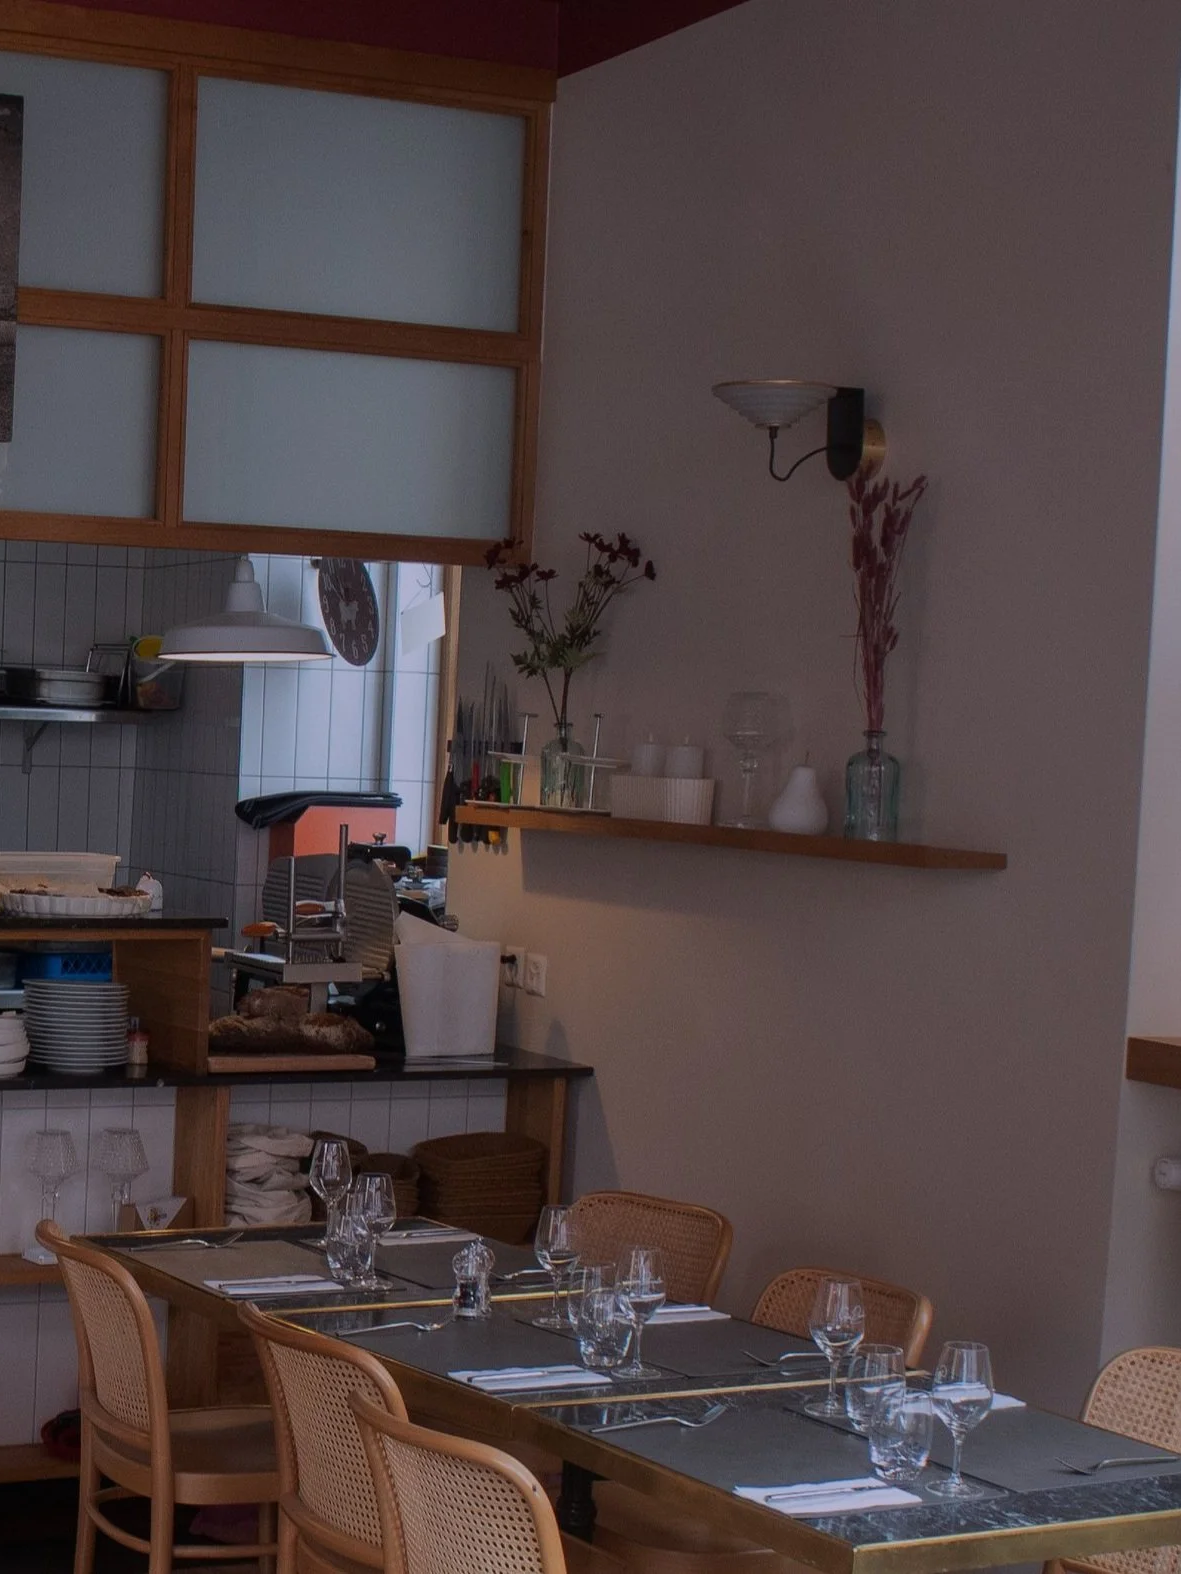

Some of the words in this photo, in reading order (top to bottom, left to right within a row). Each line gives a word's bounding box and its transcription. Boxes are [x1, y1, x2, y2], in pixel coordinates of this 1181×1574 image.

[322, 594, 329, 614] 9
[330, 616, 336, 636] 8
[367, 619, 374, 639] 4
[351, 639, 359, 659] 6
[361, 633, 368, 653] 5
